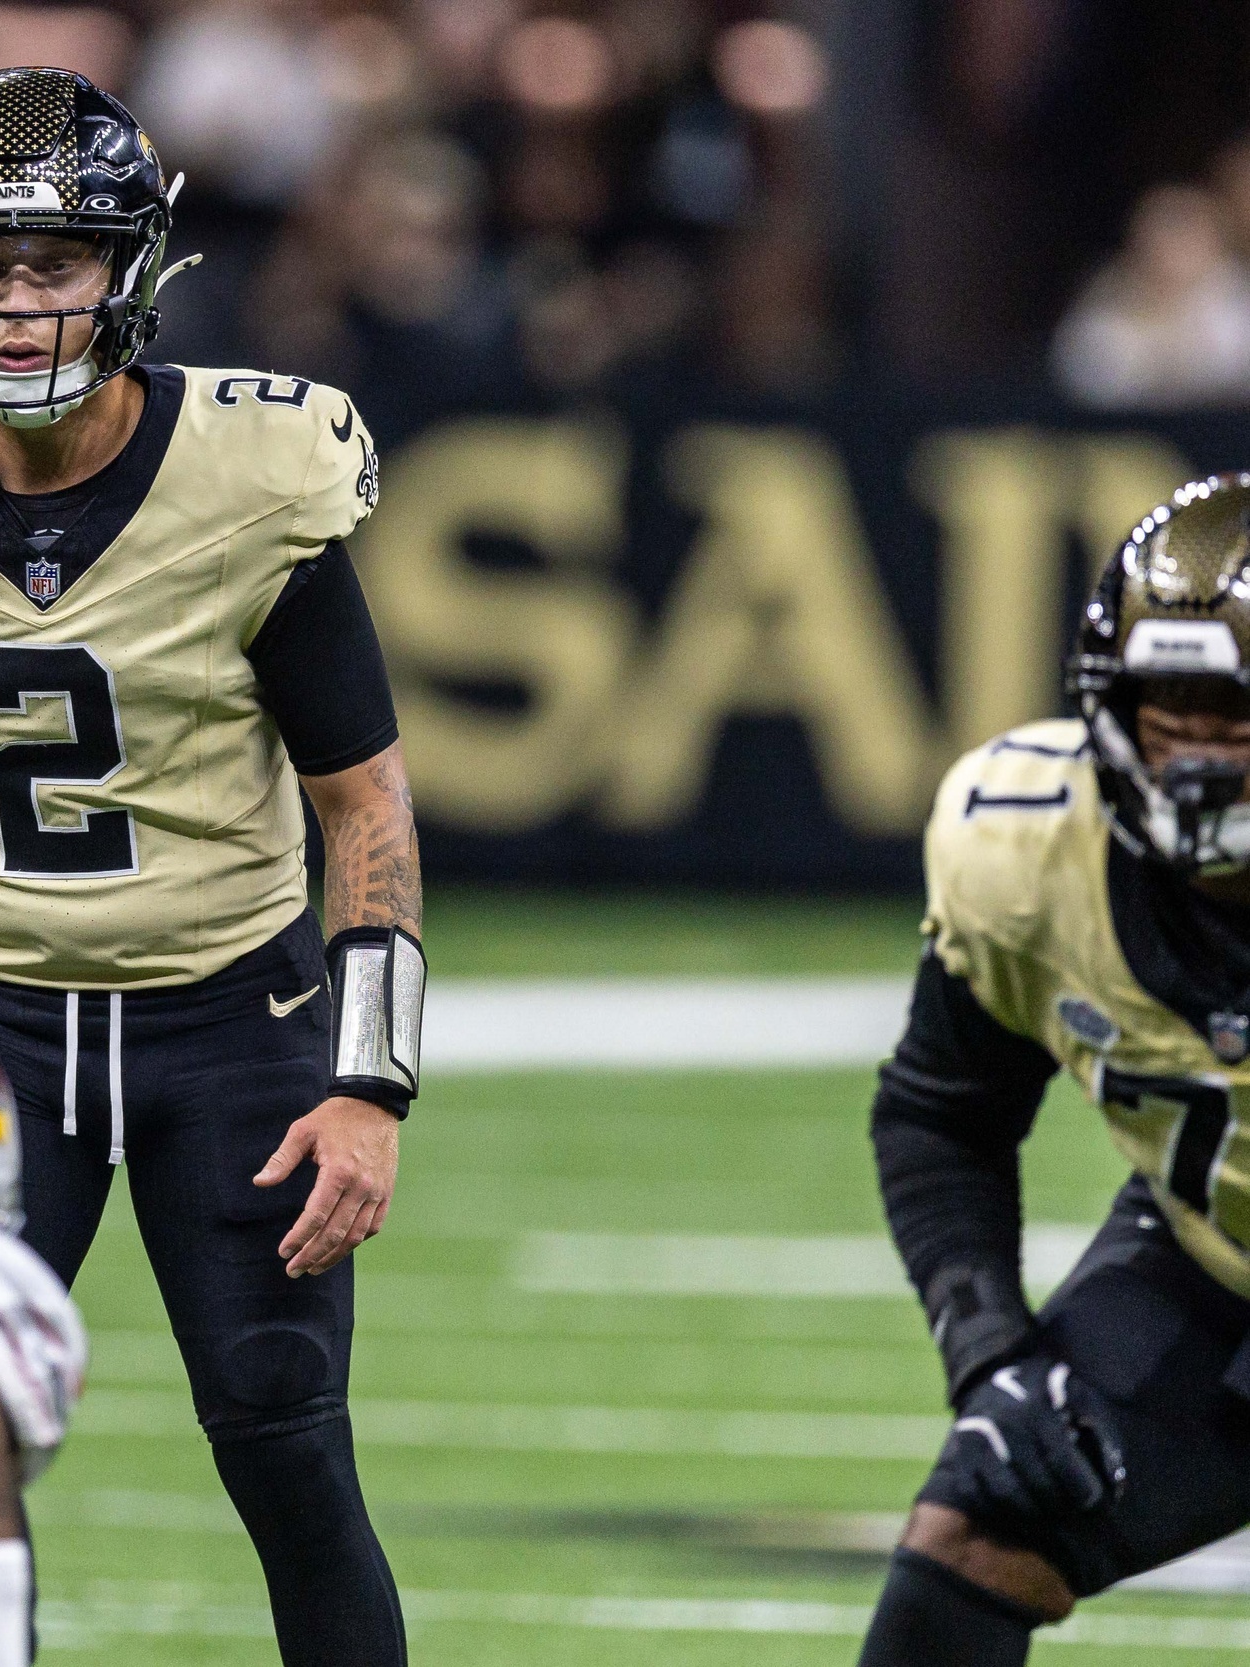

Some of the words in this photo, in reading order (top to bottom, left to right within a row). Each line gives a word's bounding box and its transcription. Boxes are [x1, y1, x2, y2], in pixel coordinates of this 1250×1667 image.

[211, 375, 316, 411] 2
[31, 577, 55, 595] NFL
[358, 408, 1195, 838] SAI
